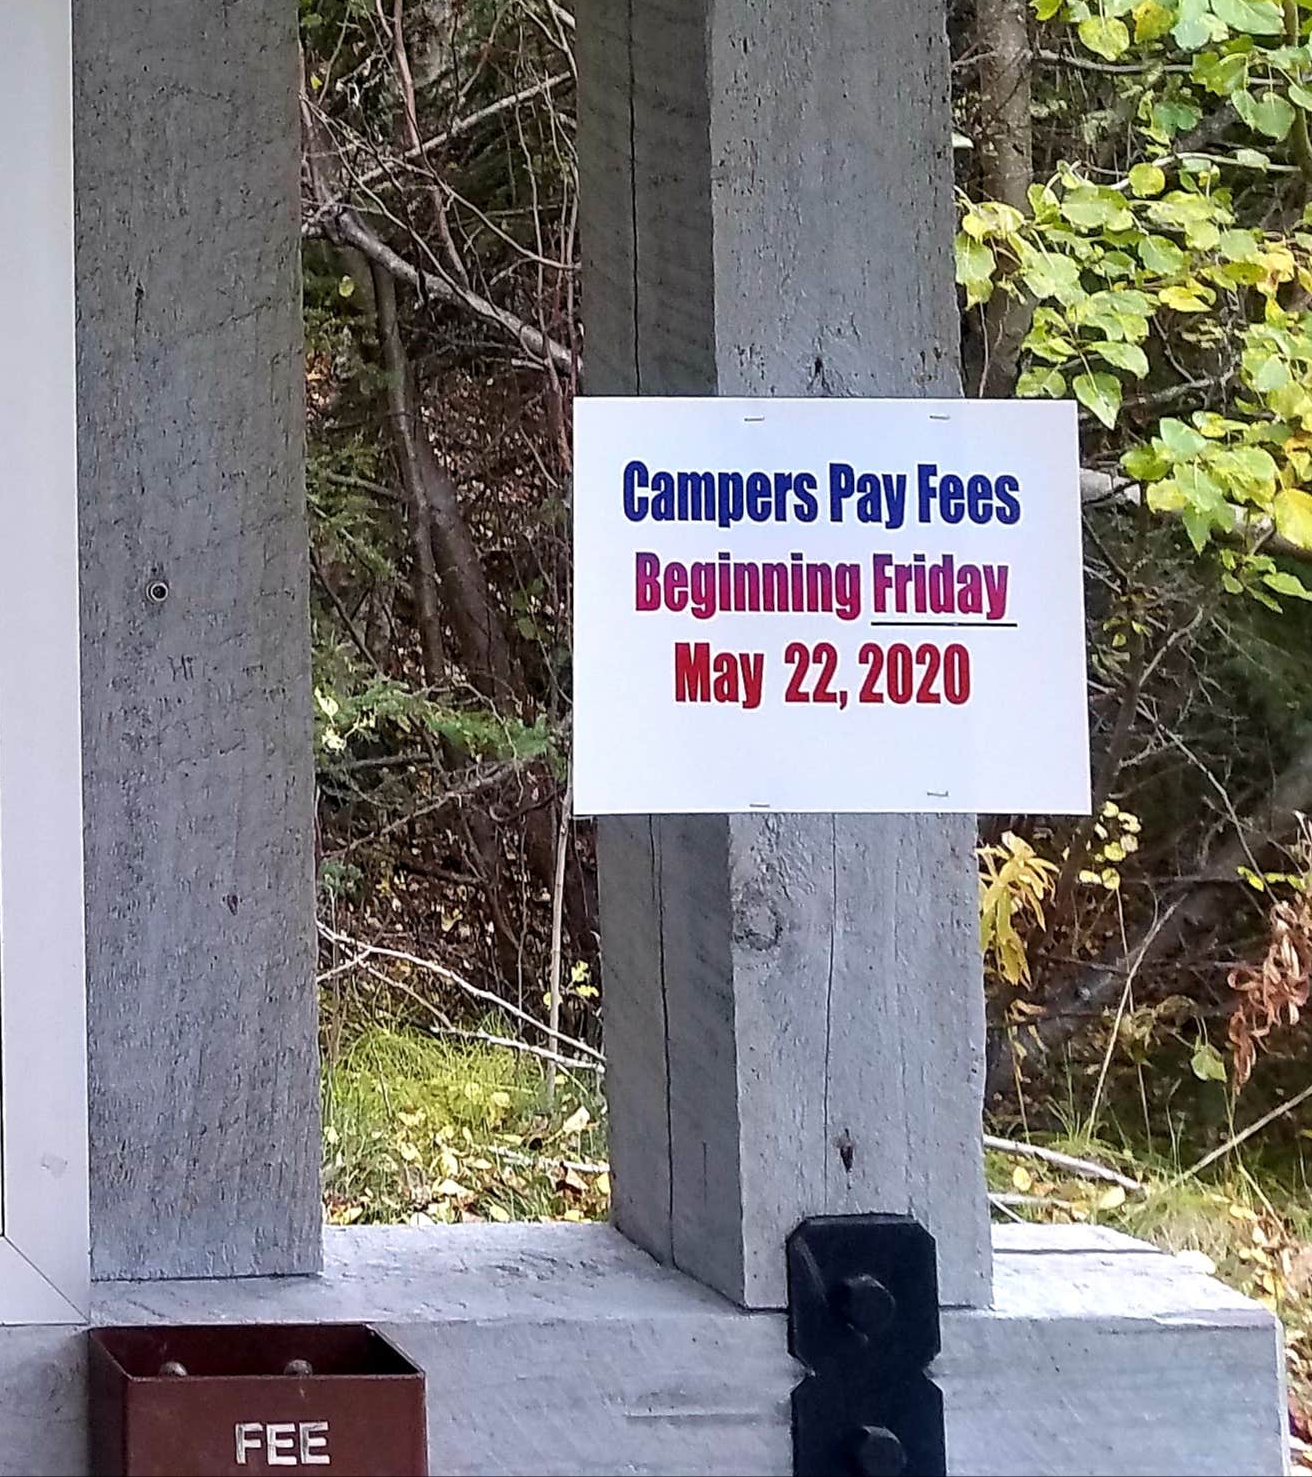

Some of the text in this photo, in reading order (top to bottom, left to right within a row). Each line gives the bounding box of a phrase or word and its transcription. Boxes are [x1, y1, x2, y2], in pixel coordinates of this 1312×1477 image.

[622, 460, 1021, 530] Campers Pay Fees
[635, 551, 1009, 621] Beginning Friday
[674, 642, 971, 711] May 22, 2020
[235, 1421, 330, 1466] FEE
